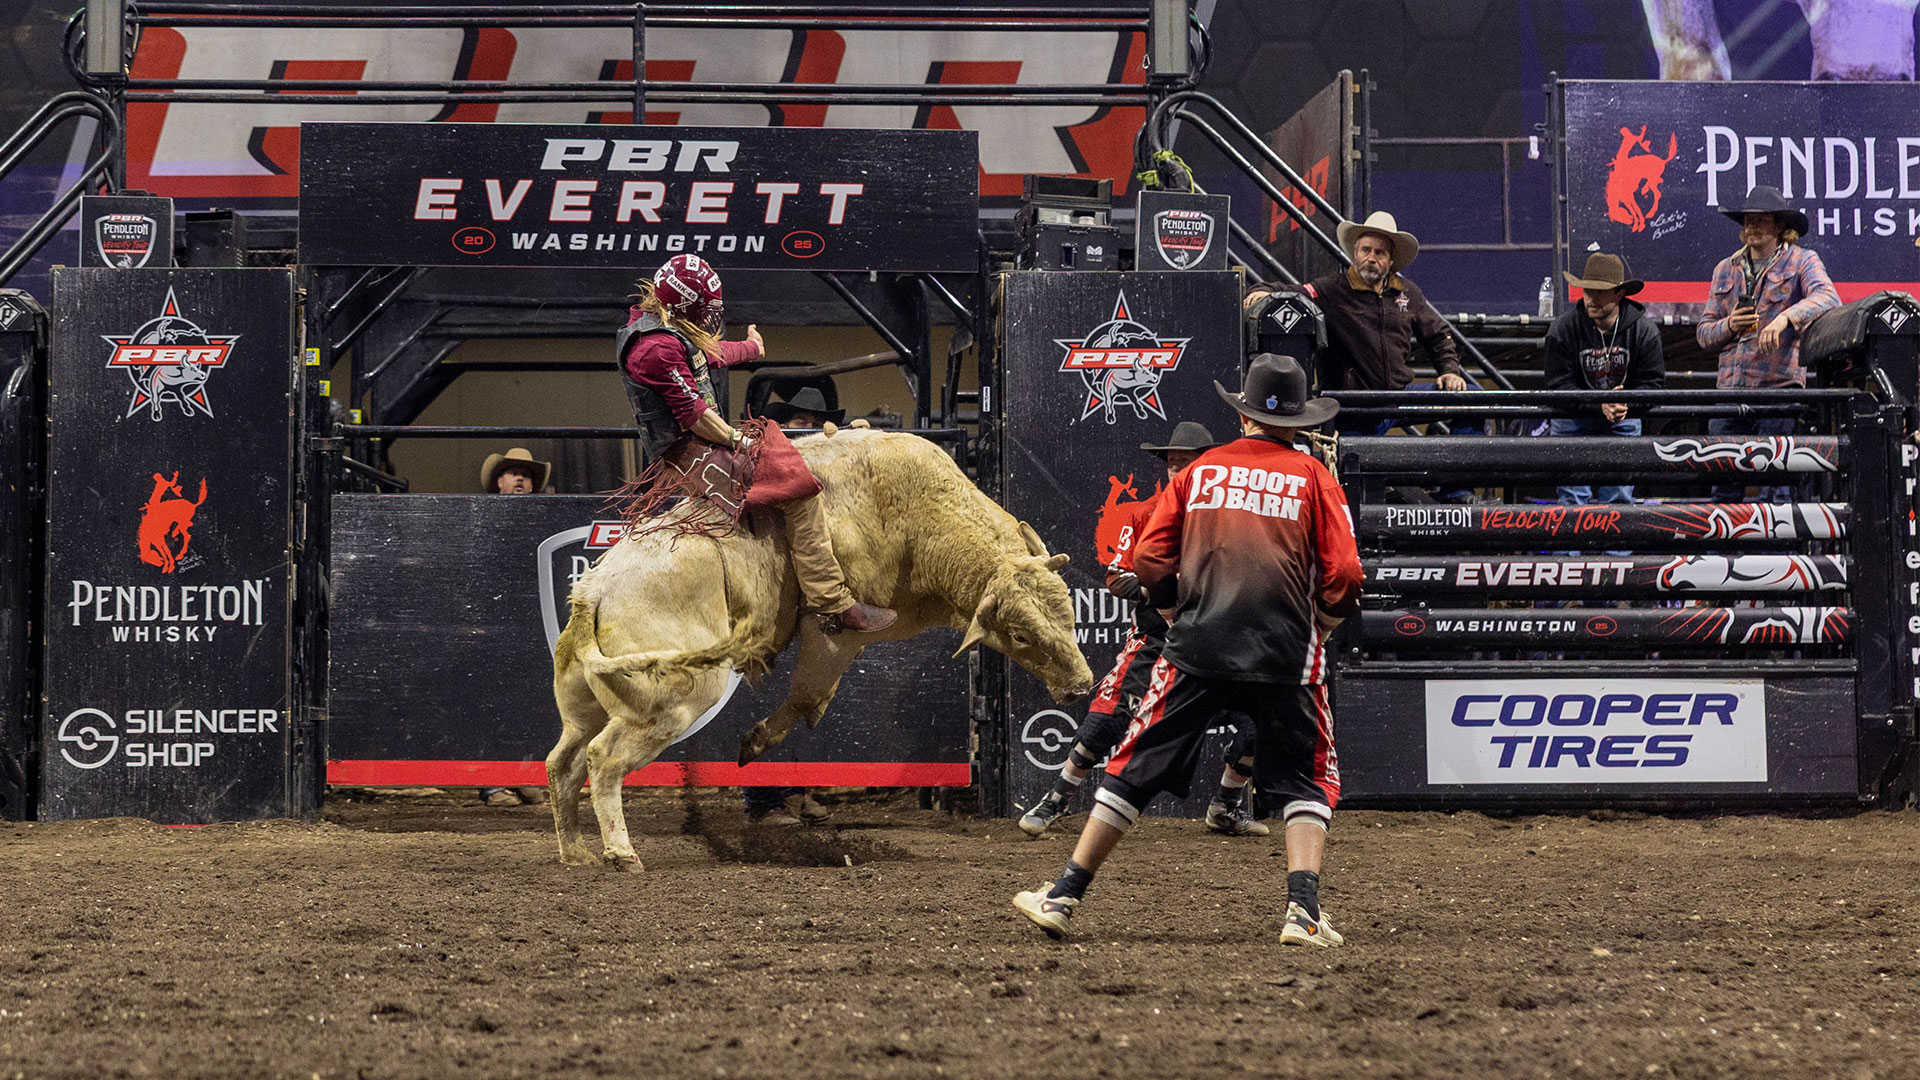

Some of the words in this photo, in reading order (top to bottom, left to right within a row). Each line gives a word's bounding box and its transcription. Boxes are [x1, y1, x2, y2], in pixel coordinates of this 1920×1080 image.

[540, 138, 739, 172] PBR
[413, 178, 864, 225] EVERETT
[103, 223, 149, 235] PENDLETON
[1162, 218, 1207, 233] PENDLETON
[463, 235, 484, 245] 20
[511, 232, 765, 252] WASHINGTON
[793, 239, 813, 249] 25
[117, 348, 223, 362] PBR
[1070, 351, 1175, 366] PBR
[1228, 466, 1307, 496] BOOT
[1224, 489, 1301, 521] BARN
[1385, 506, 1472, 528] PENDLETON
[1375, 567, 1446, 581] PBR
[1456, 561, 1635, 587] EVERETT
[67, 579, 264, 627] PENDLETON
[112, 626, 218, 642] WHISKY
[1435, 620, 1576, 632] WASHINGTON
[125, 709, 279, 734] SILENCER
[1450, 693, 1739, 727] COOPER
[125, 743, 215, 767] SHOP
[1489, 734, 1694, 769] TIRES
